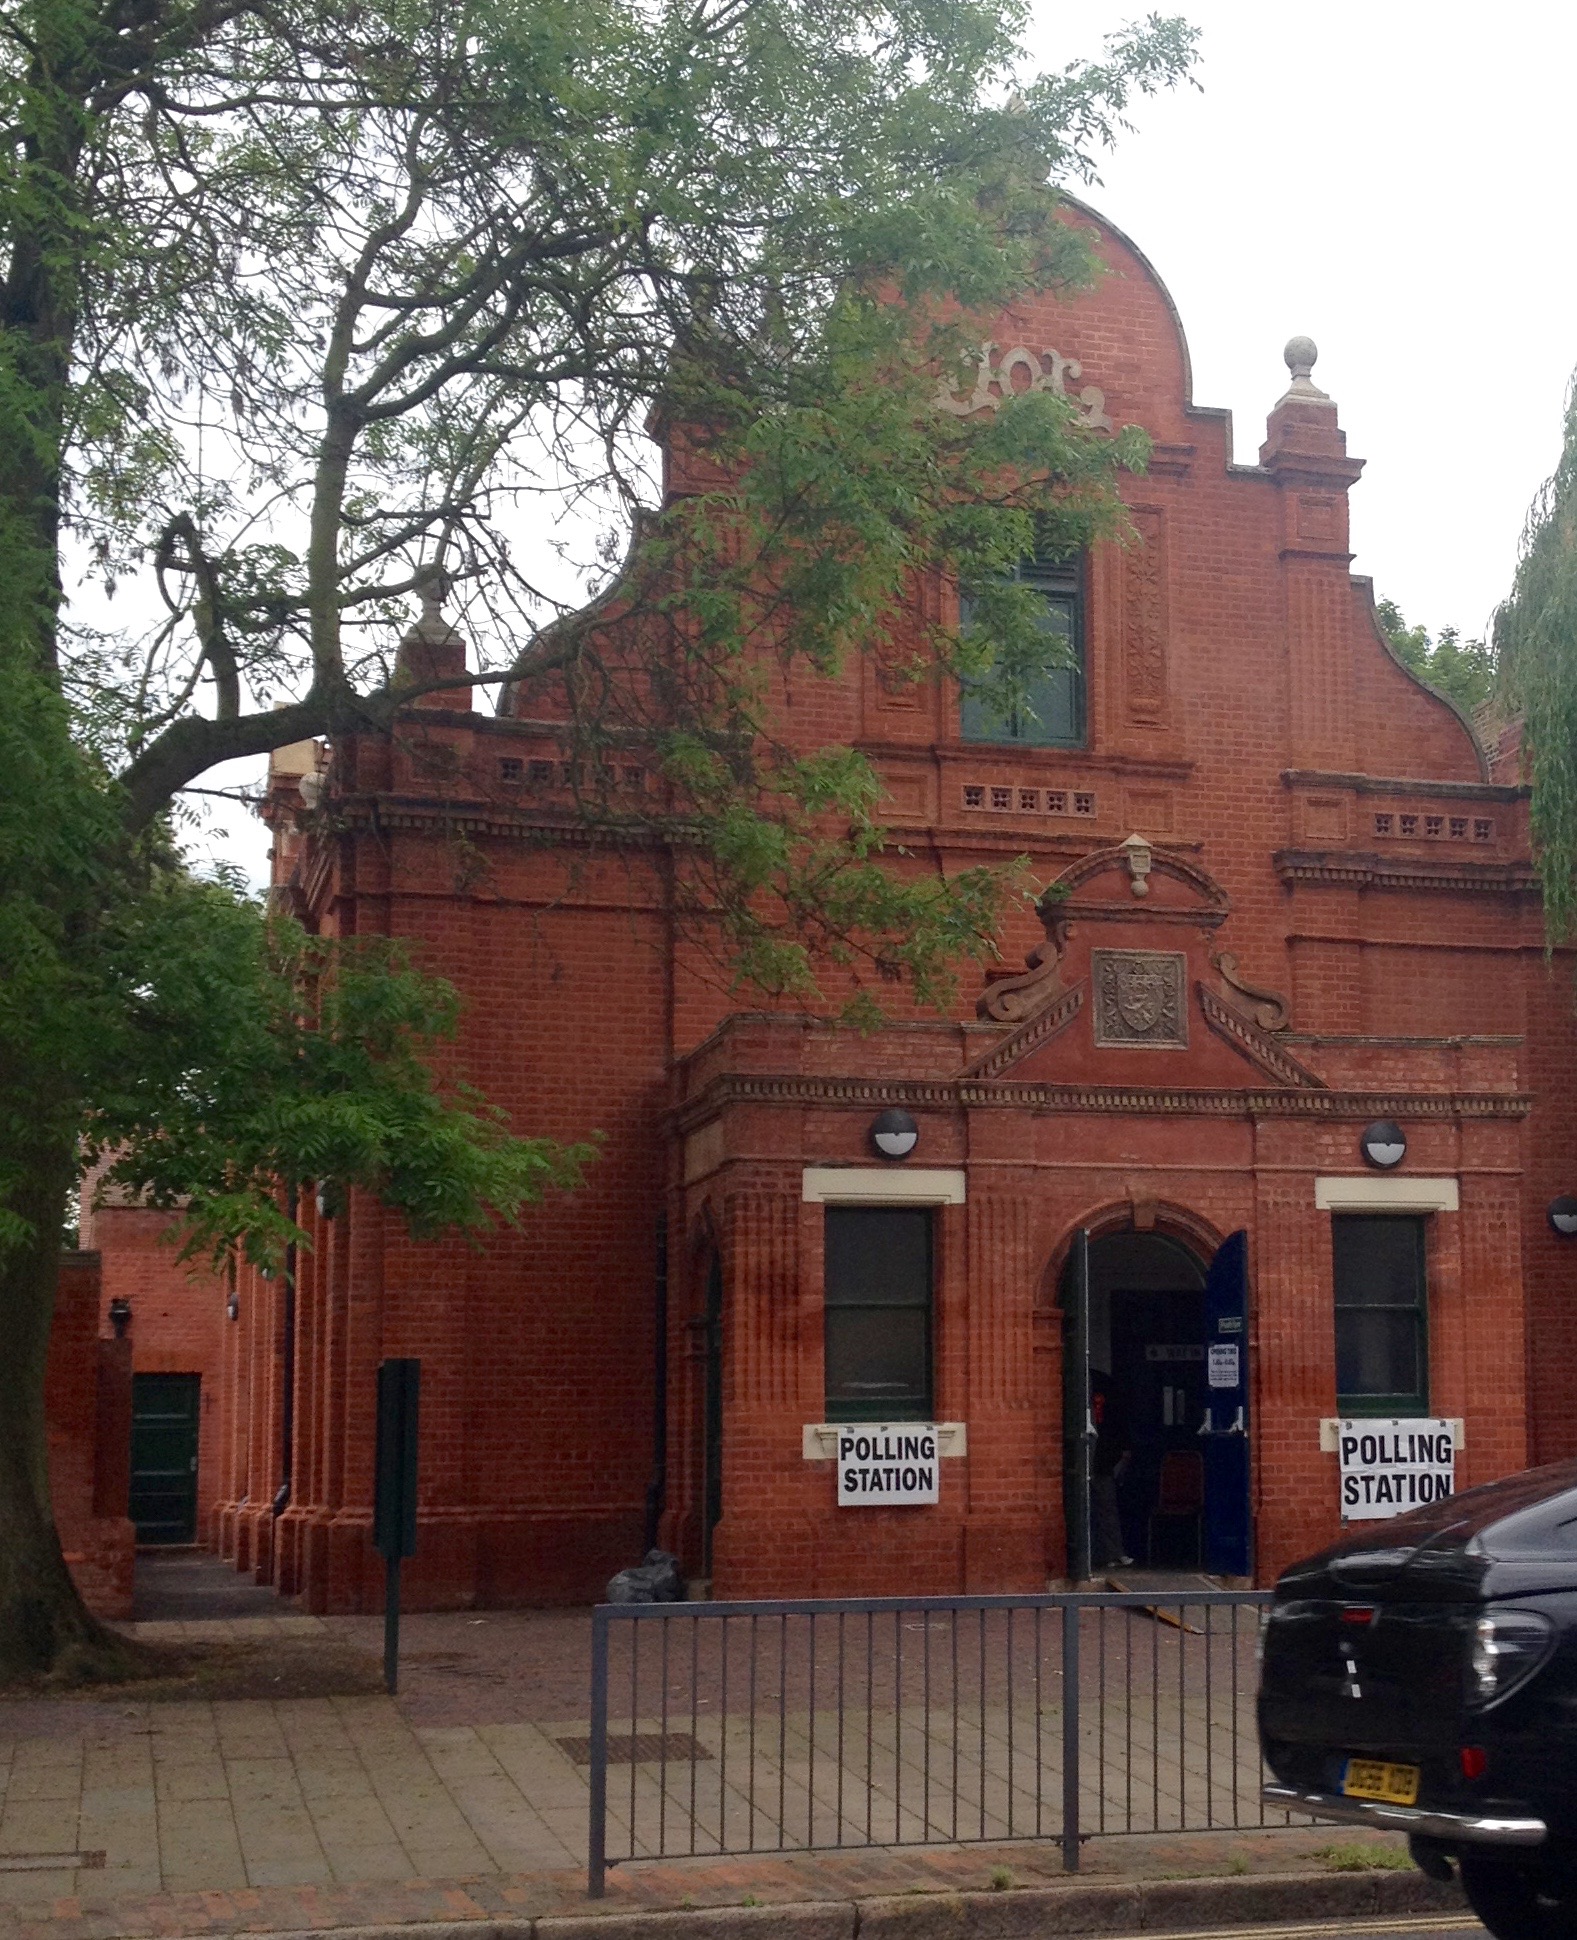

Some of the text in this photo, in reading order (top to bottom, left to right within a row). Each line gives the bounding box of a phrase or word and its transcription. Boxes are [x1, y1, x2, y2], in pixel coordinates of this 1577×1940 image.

[841, 1436, 935, 1461] POLLING
[1342, 1434, 1452, 1465] POLLING
[844, 1467, 933, 1492] STATION
[1344, 1473, 1451, 1505] STATION
